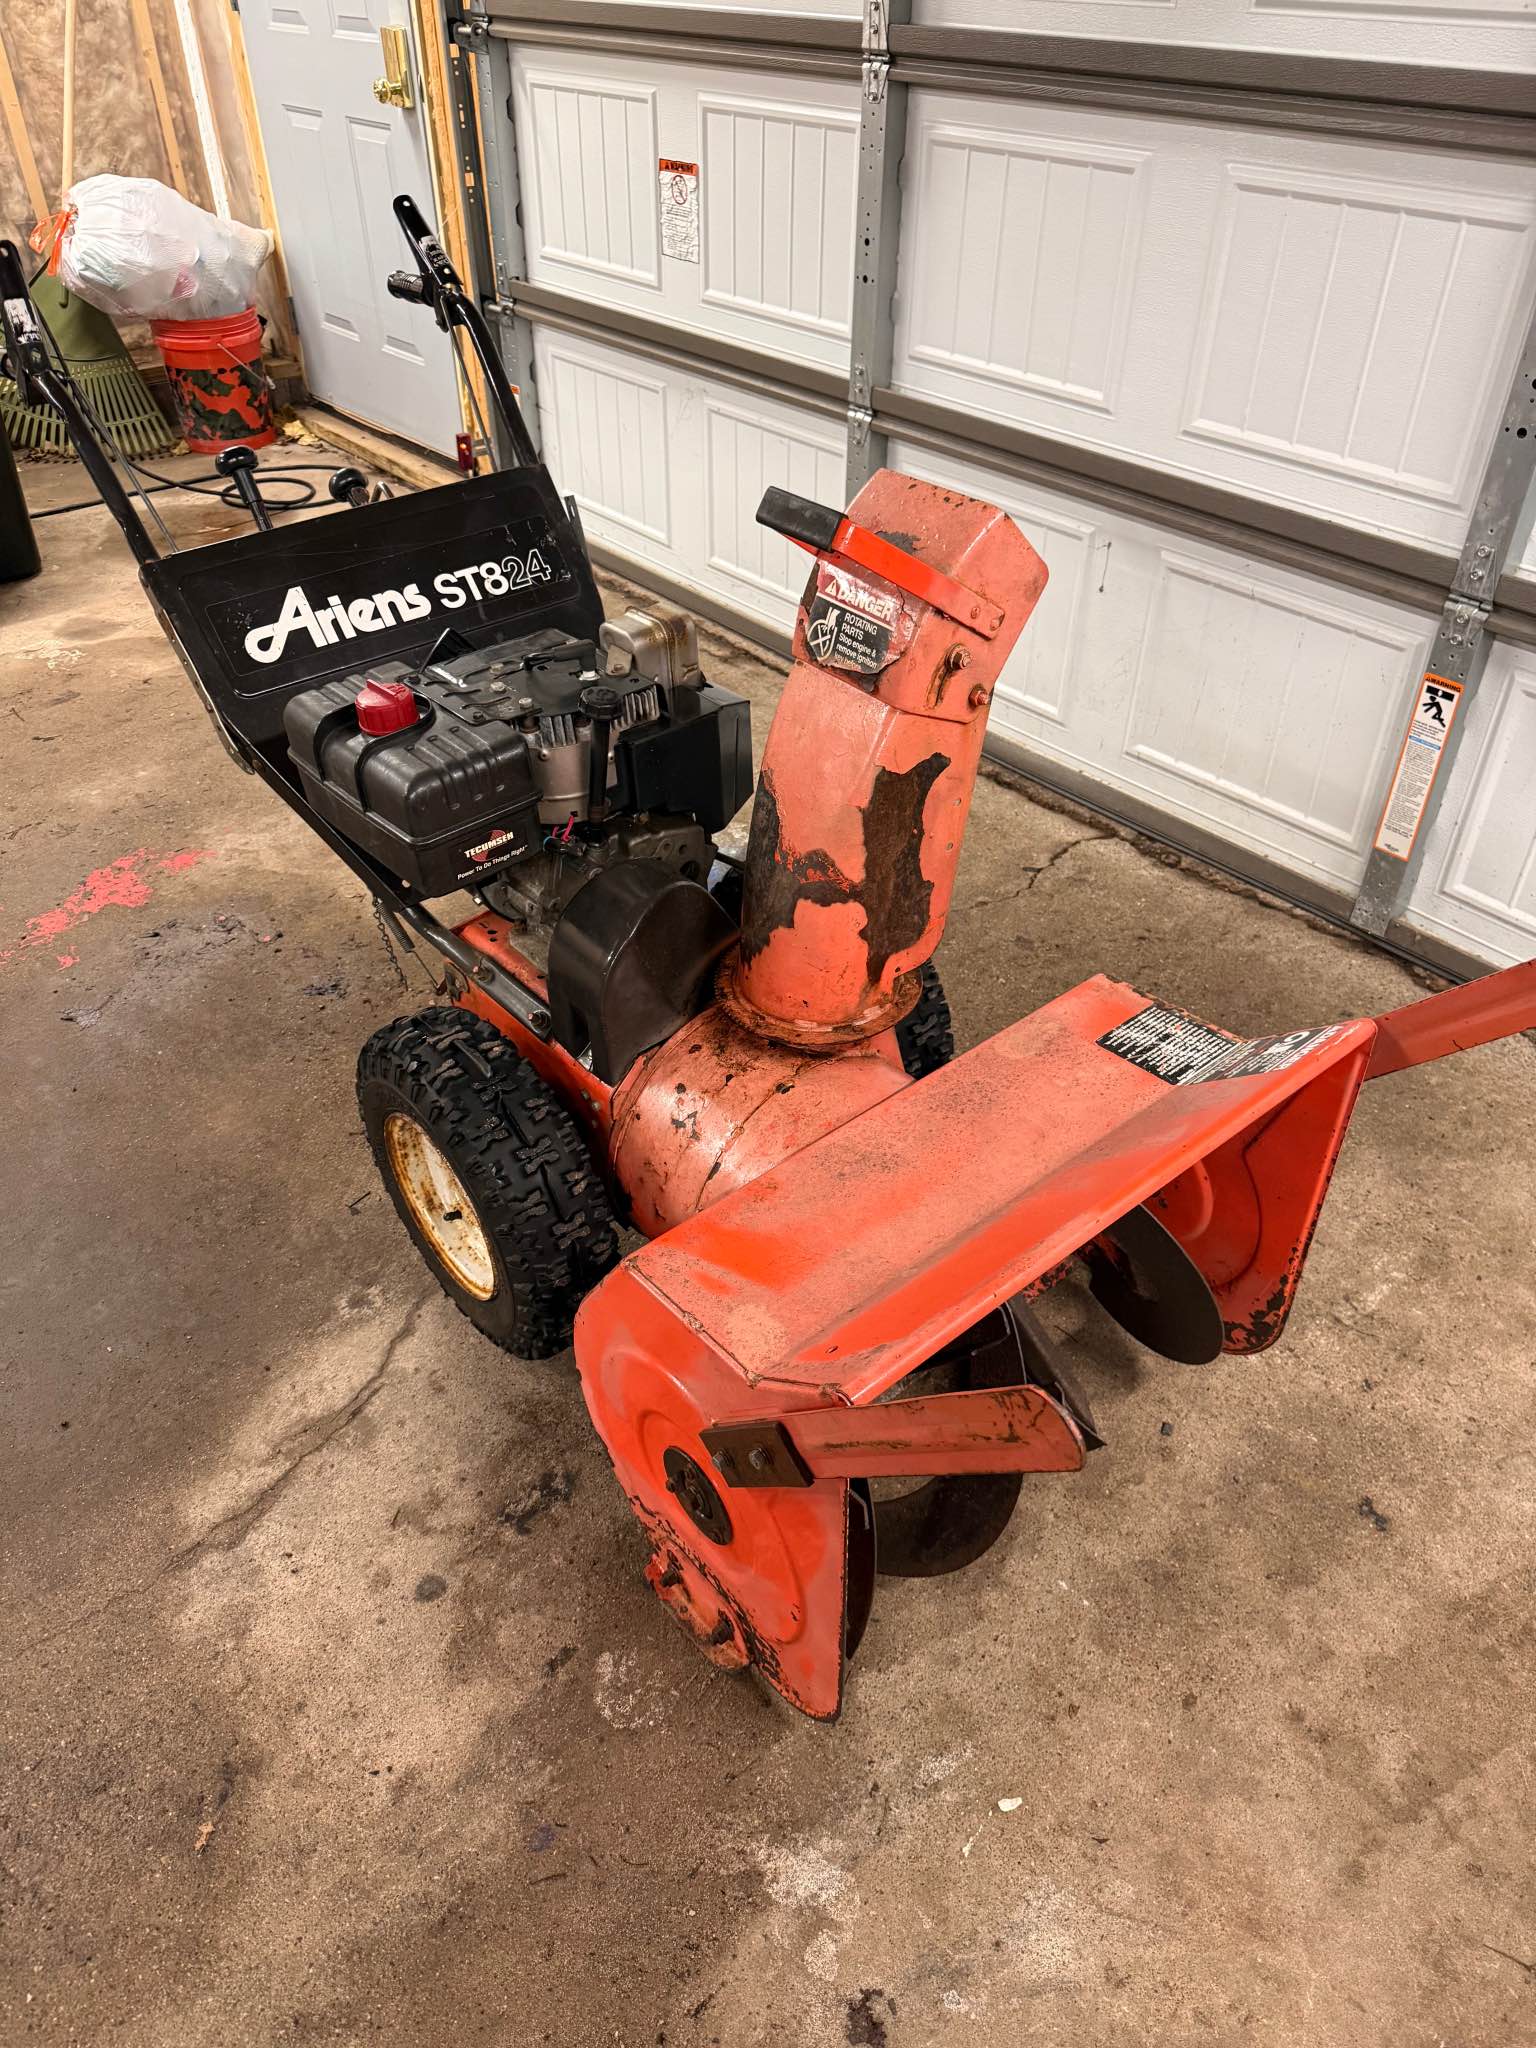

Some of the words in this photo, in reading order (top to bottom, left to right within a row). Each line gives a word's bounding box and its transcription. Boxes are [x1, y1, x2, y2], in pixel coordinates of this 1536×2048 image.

[244, 583, 432, 664] Ariens
[434, 549, 552, 609] ST824
[837, 587, 894, 621] DANGER
[841, 623, 864, 640] PARTS
[844, 612, 878, 635] ROTATING
[836, 643, 857, 658] remove
[857, 652, 878, 669] ignition
[839, 633, 853, 647] Stop
[852, 641, 872, 655] engine
[871, 649, 877, 658] &
[1430, 678, 1461, 693] WARNING
[464, 831, 514, 858] TECUMSEH
[457, 869, 476, 880] Power
[483, 861, 492, 869] Do
[492, 853, 511, 865] Things
